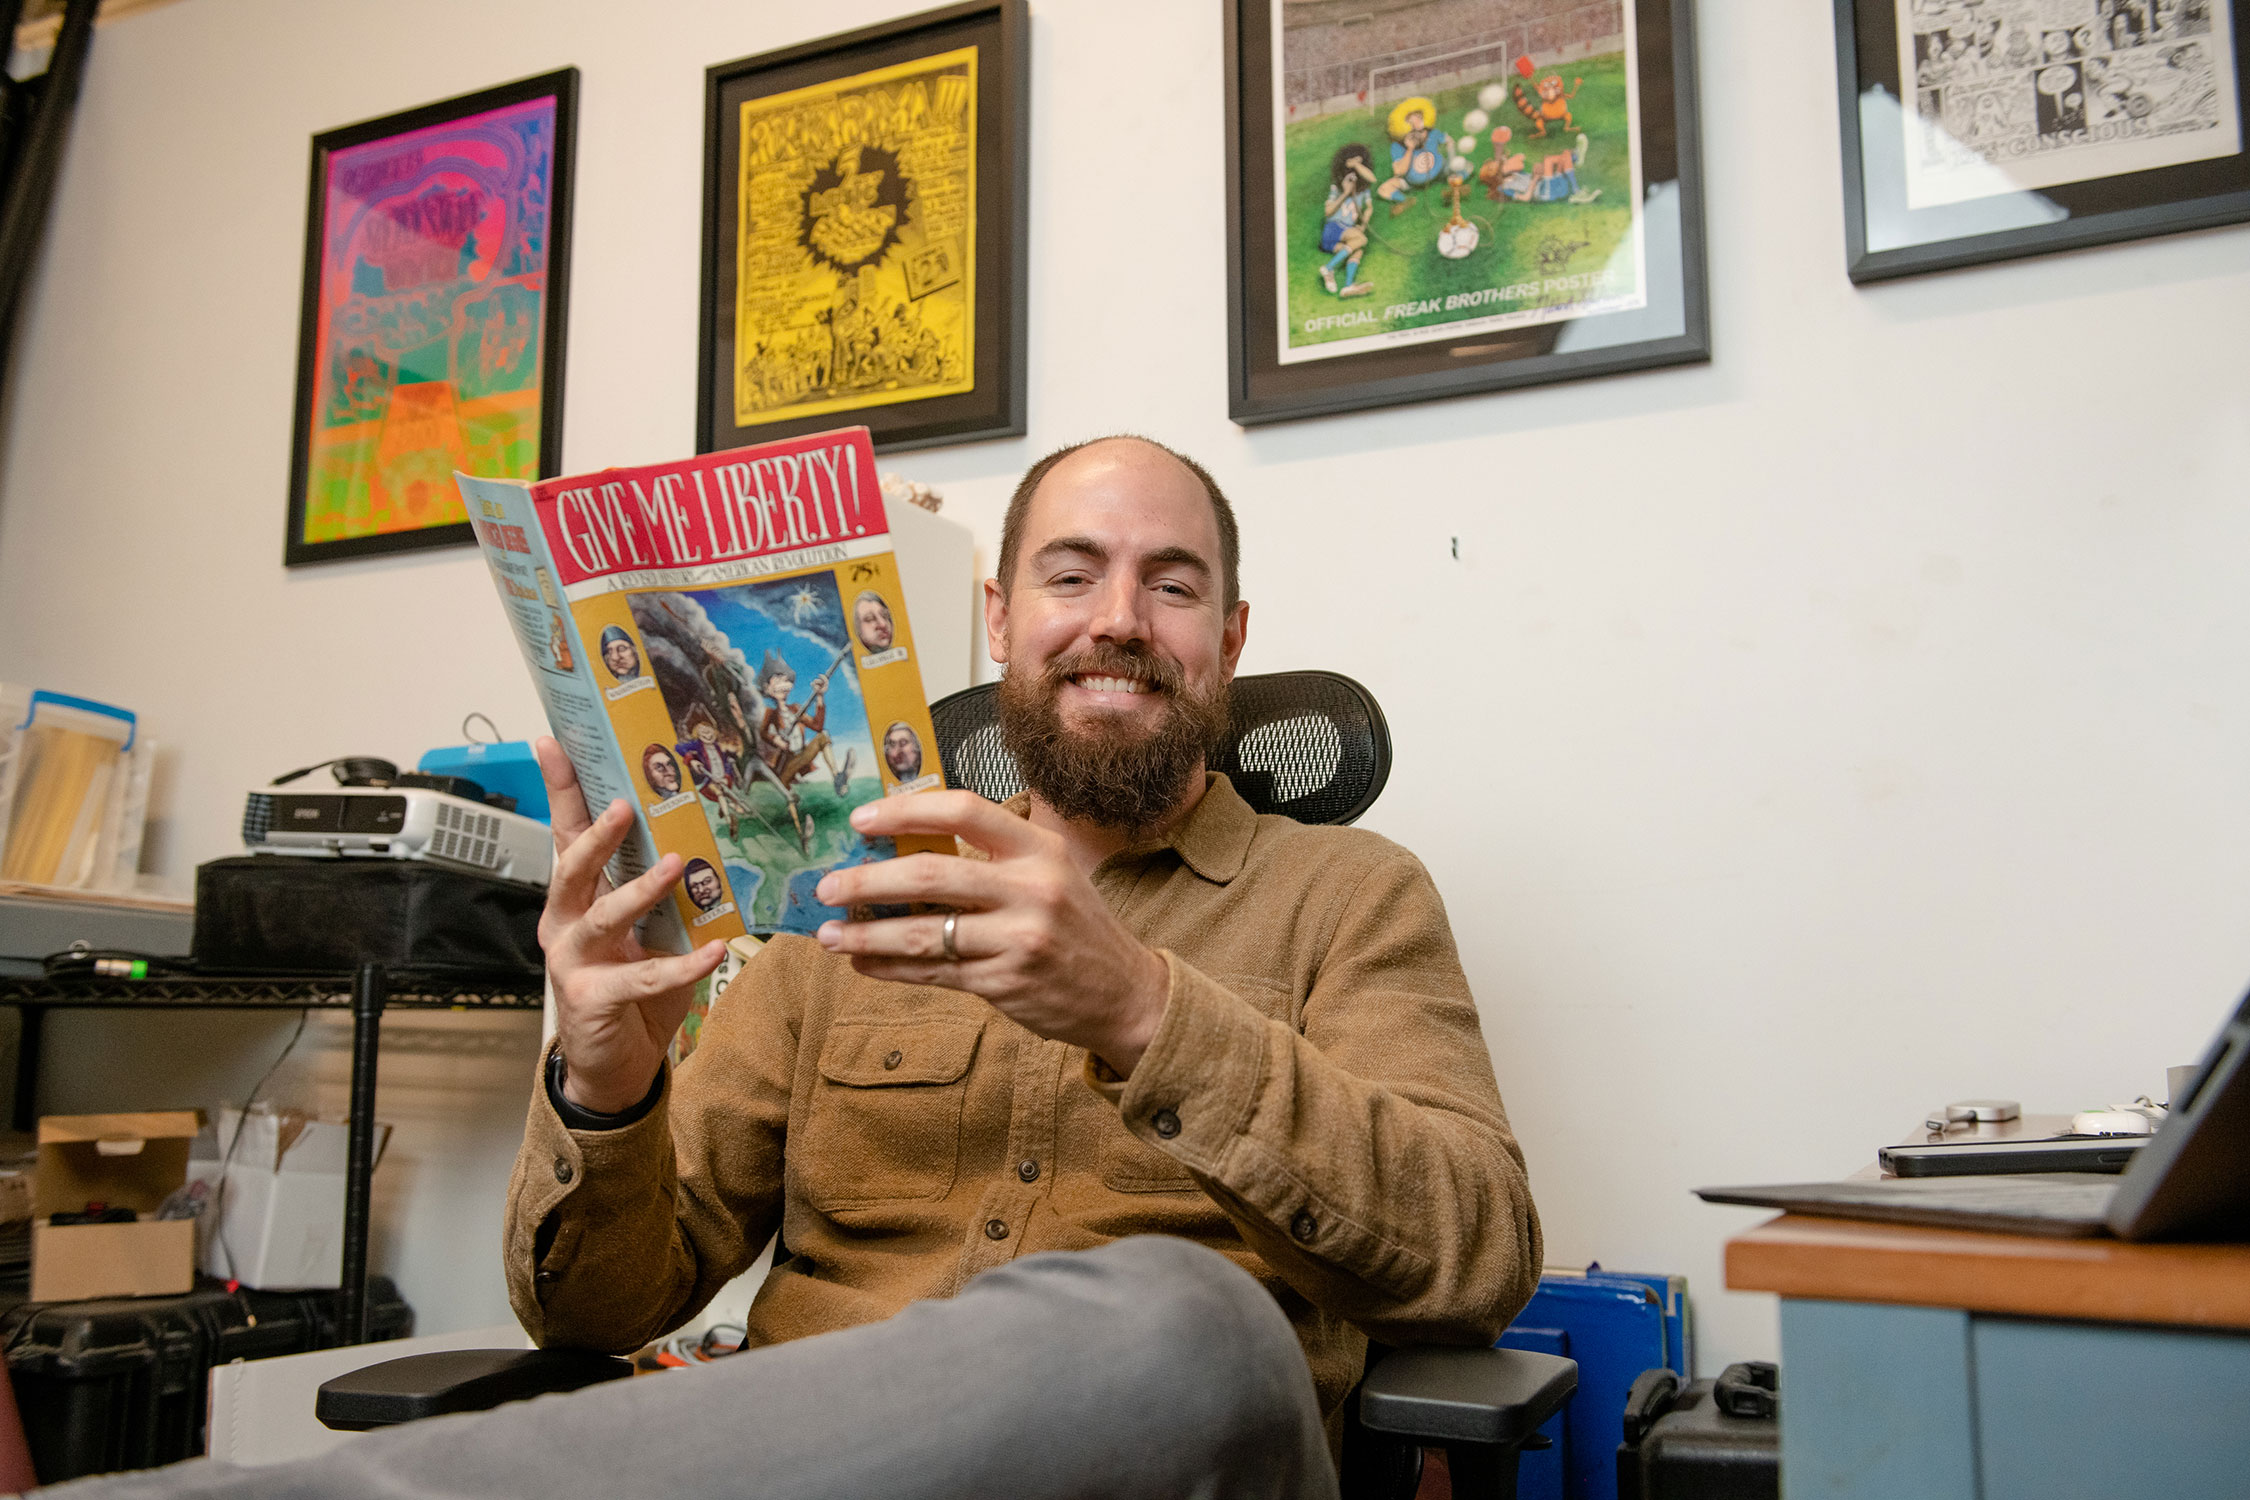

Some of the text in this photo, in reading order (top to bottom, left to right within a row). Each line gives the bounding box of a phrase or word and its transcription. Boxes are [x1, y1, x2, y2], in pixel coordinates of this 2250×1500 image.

[1304, 309, 1378, 333] OFFICIAL
[1383, 298, 1443, 320] FREAK
[1445, 280, 1541, 310] BROTHERS
[1543, 269, 1617, 293] POSTER
[556, 443, 867, 574] GIVE ME LIBERTY!
[711, 559, 770, 581] AMERICAN
[770, 542, 849, 571] REVOLUTION
